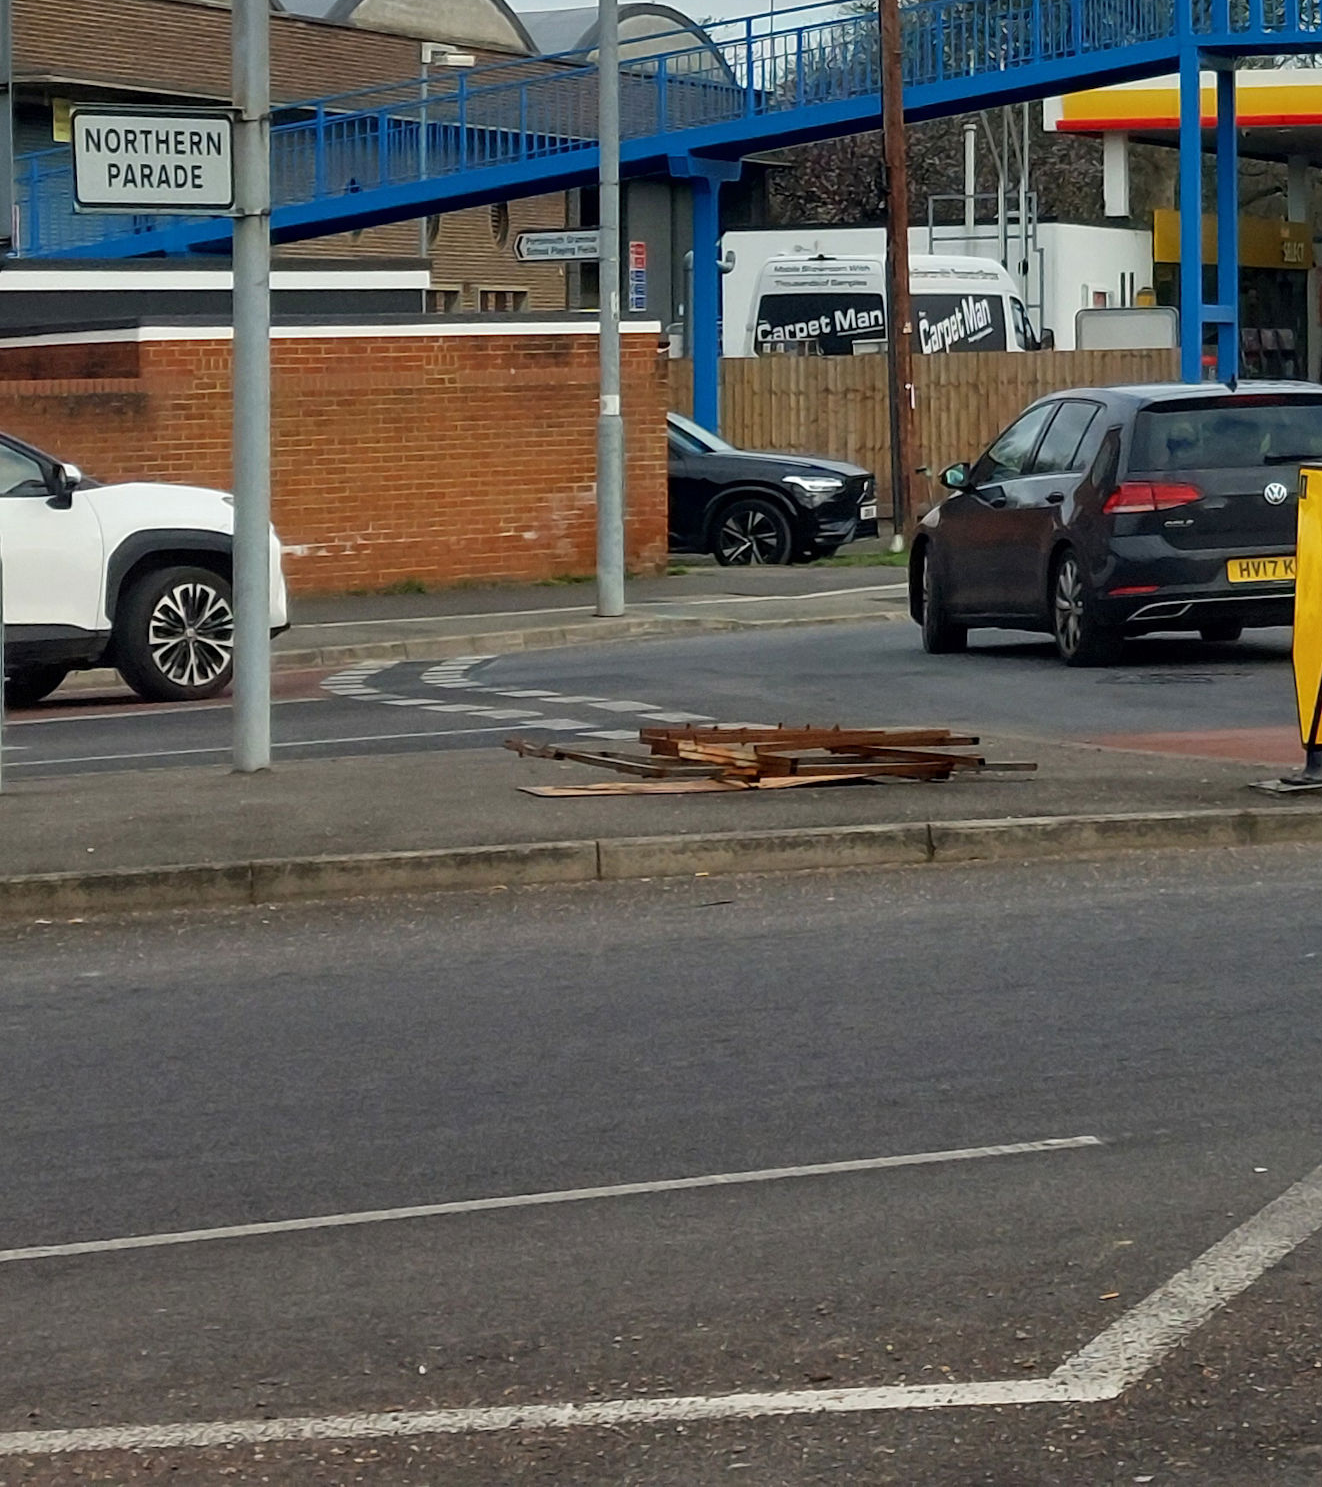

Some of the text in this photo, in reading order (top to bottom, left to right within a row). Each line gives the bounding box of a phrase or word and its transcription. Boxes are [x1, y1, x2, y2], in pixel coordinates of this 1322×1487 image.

[85, 128, 222, 156] NORTHERN
[107, 163, 204, 189] PARADE
[757, 308, 884, 342] Carpet Man
[919, 296, 992, 355] Carpet Man
[1238, 559, 1277, 579] HV17
